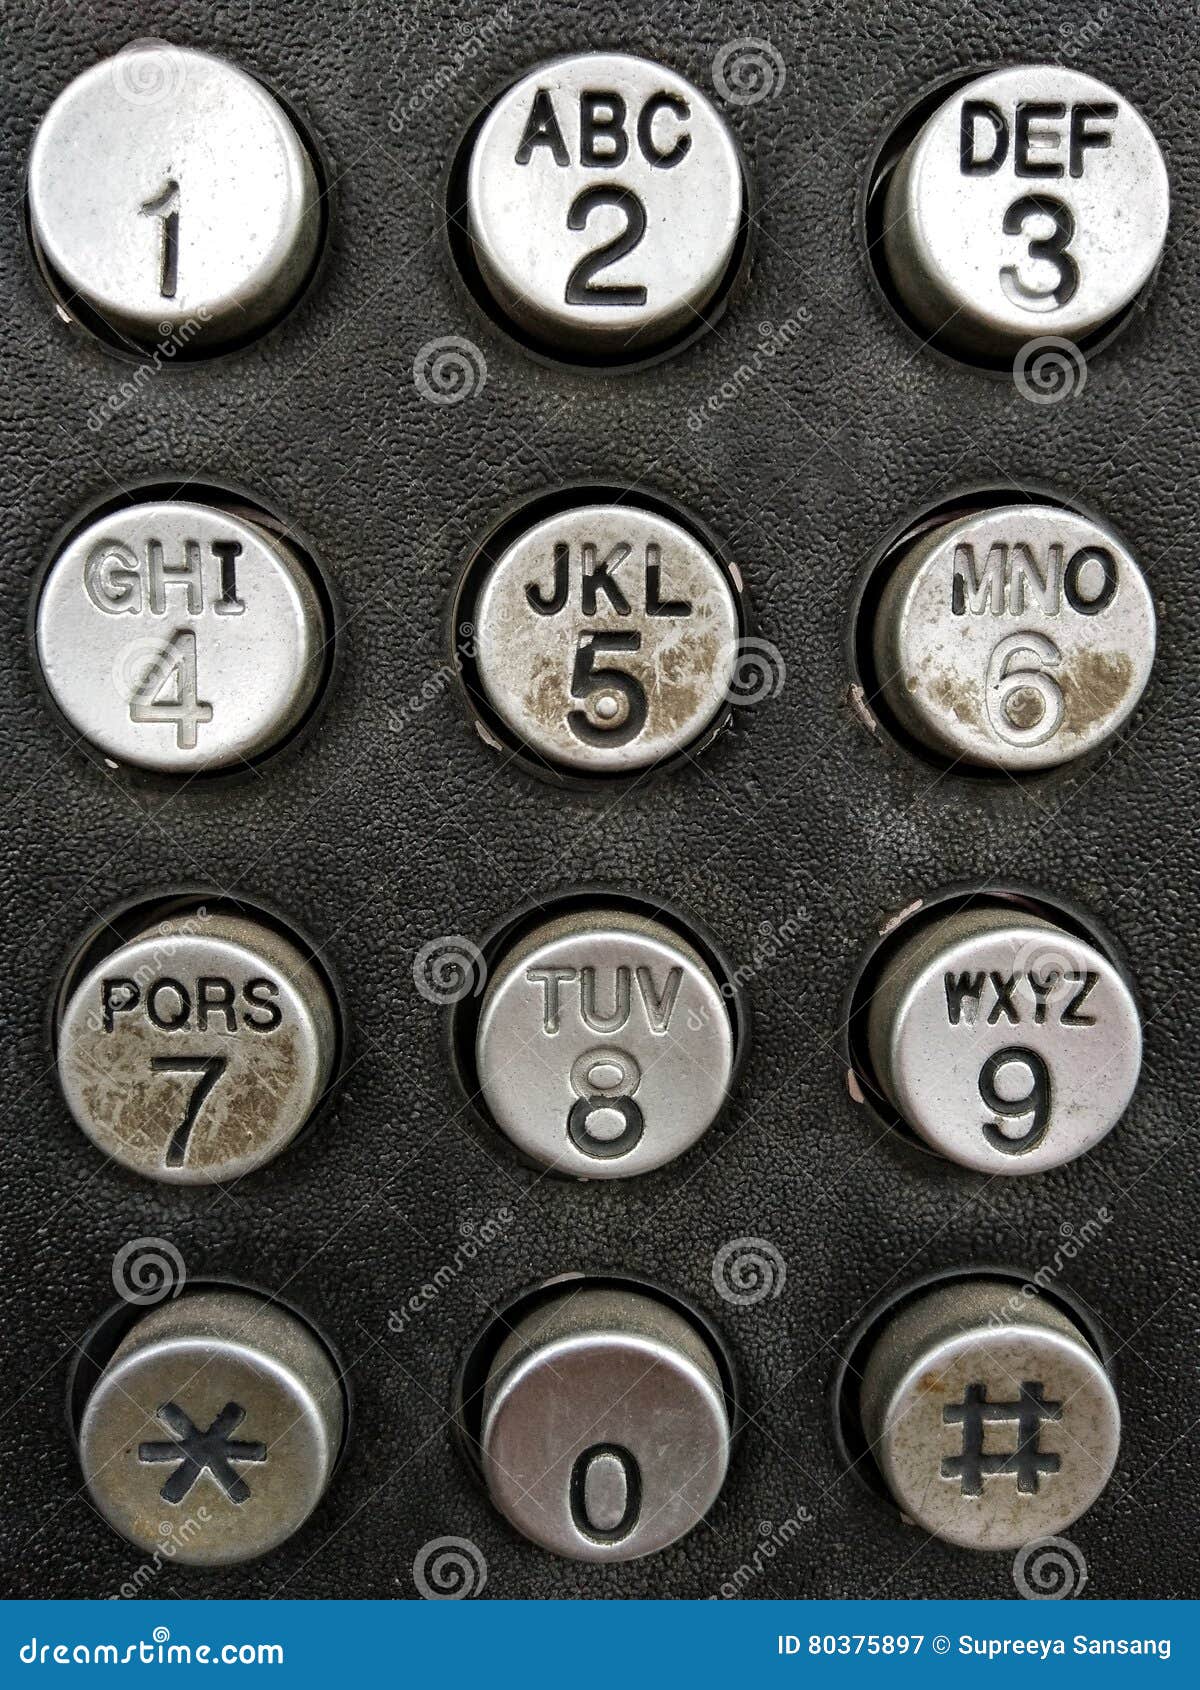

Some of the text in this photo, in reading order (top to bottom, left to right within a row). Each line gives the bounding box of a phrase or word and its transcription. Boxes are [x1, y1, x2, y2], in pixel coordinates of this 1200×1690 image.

[514, 88, 692, 169] ABC
[960, 100, 1118, 178] DEF
[139, 178, 180, 298] 1
[565, 183, 647, 306] 2
[1000, 193, 1081, 312] 3
[84, 538, 246, 616] GHI
[524, 541, 692, 616] JKL
[952, 541, 1119, 616] MNO
[130, 628, 213, 750] 4
[567, 629, 648, 749] 5
[985, 630, 1064, 747] 6
[101, 977, 283, 1034] PQRS
[527, 966, 684, 1036] TUV
[944, 970, 1099, 1027] WXYZ
[151, 1056, 227, 1168] 7
[568, 1045, 644, 1159] 8
[978, 1045, 1053, 1156] 9
[569, 1442, 643, 1547] 0
[941, 1381, 1063, 1498] #
